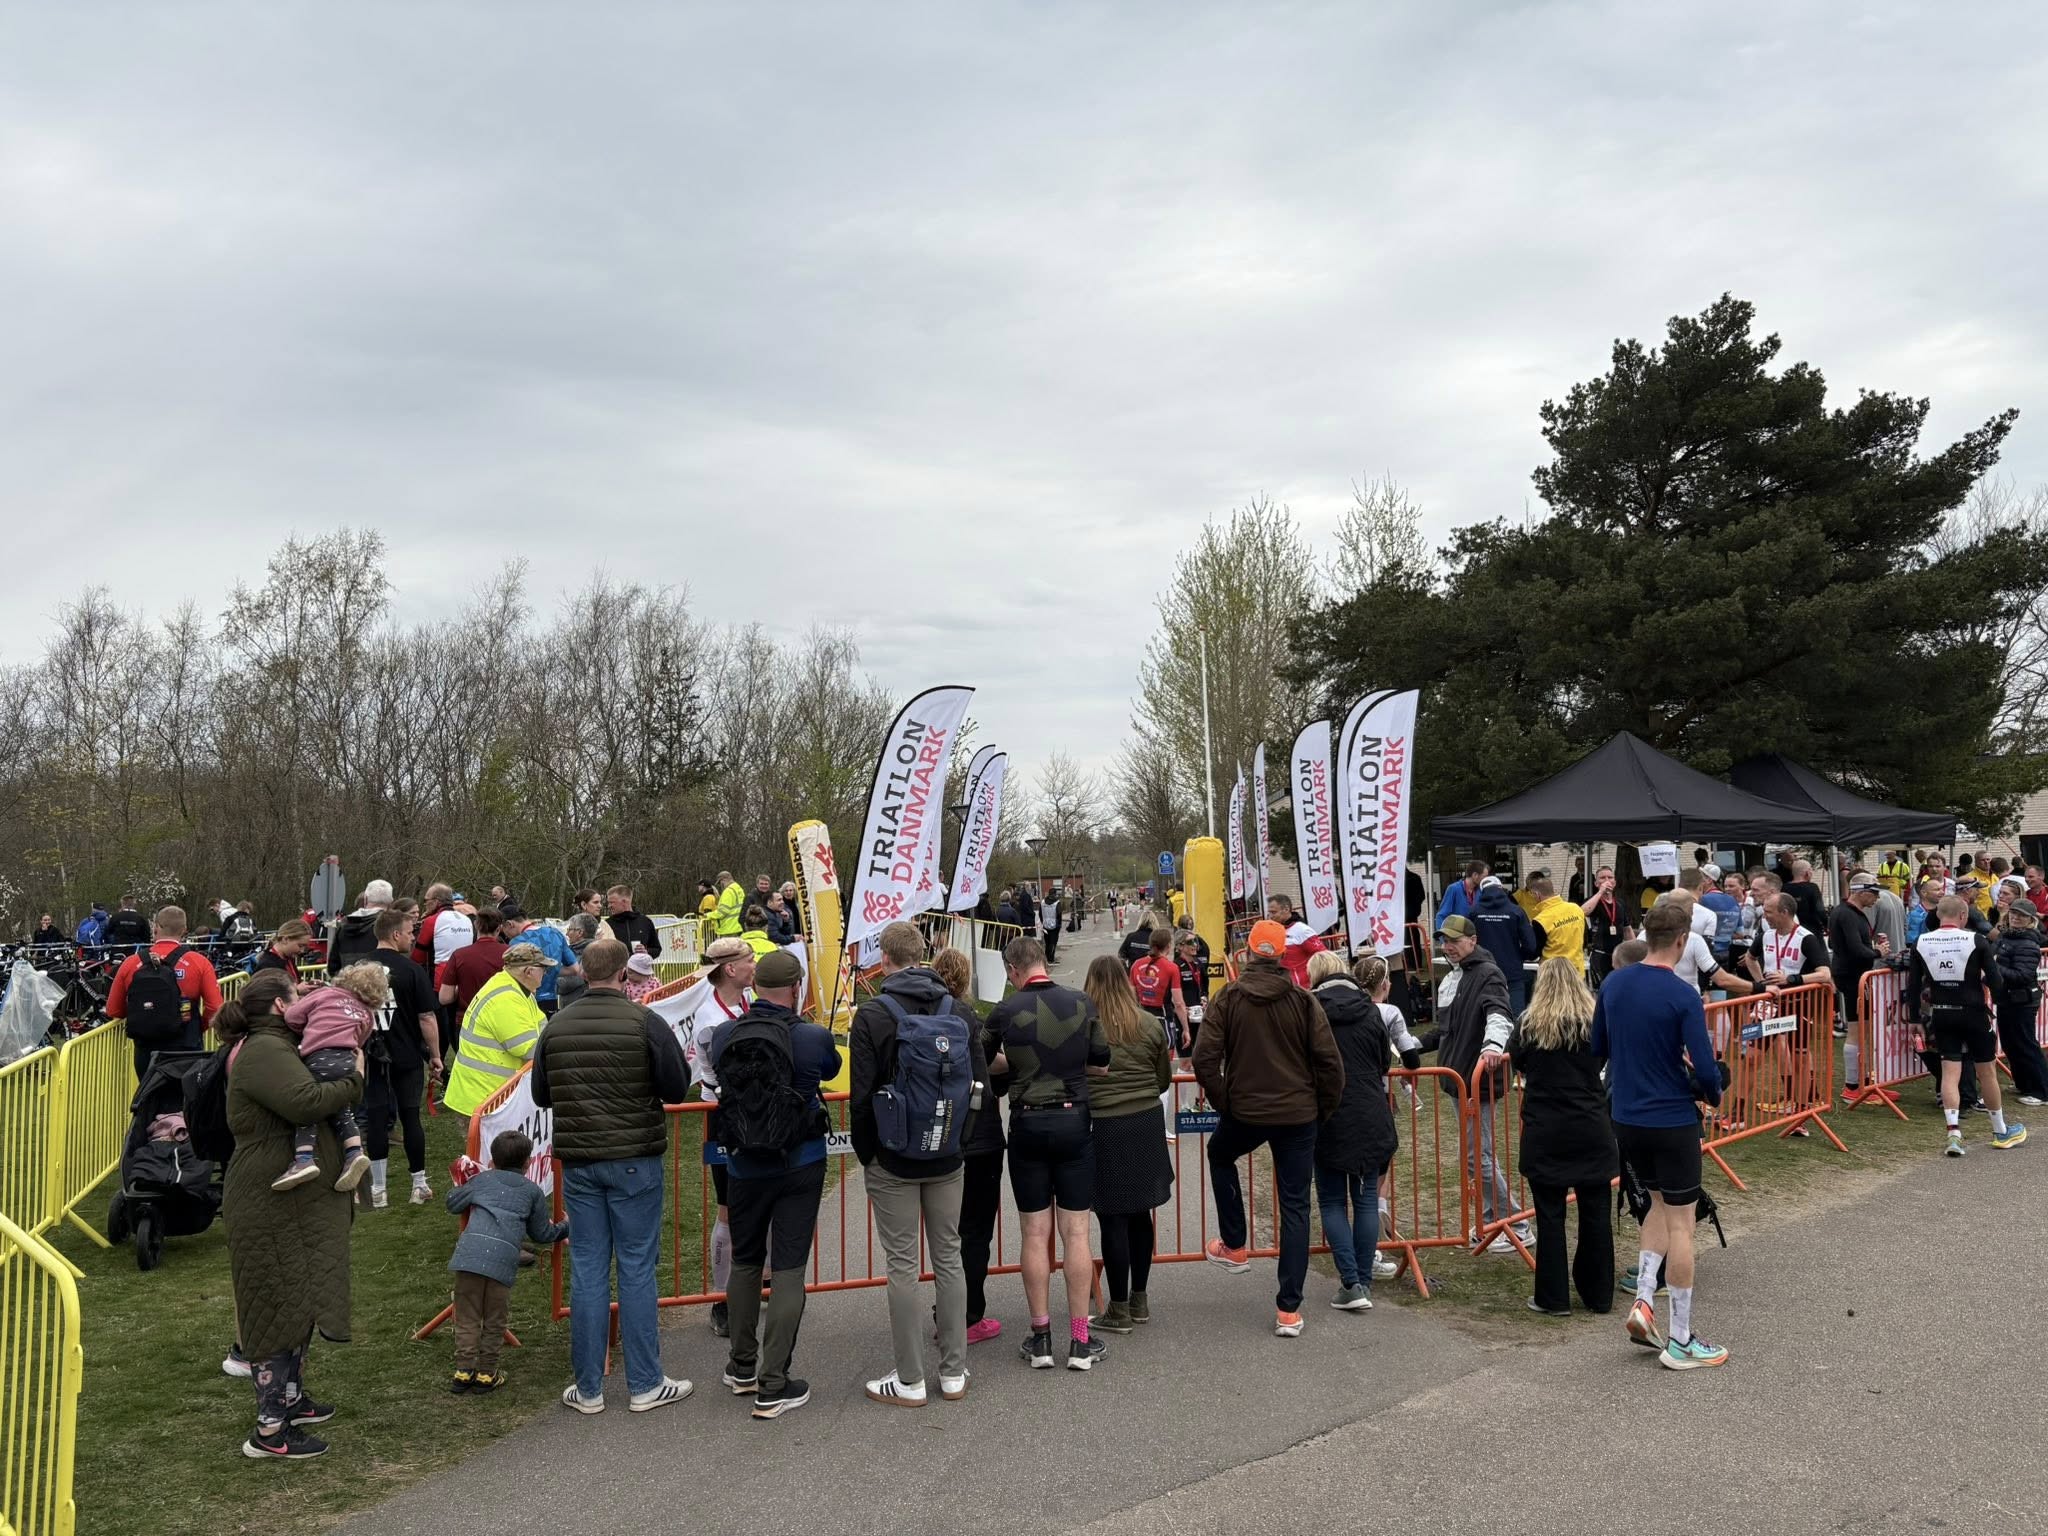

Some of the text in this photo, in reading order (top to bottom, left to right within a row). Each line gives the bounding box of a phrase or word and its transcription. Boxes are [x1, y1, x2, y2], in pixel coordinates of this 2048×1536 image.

[869, 719, 925, 877] TRIATLON
[891, 726, 946, 884] DANMARK
[974, 784, 995, 874] DANMARK
[1300, 759, 1321, 877] TRIATLON
[1312, 759, 1331, 875] DANMARK
[1377, 736, 1404, 901] DANMARK
[1939, 960, 1953, 969] AC
